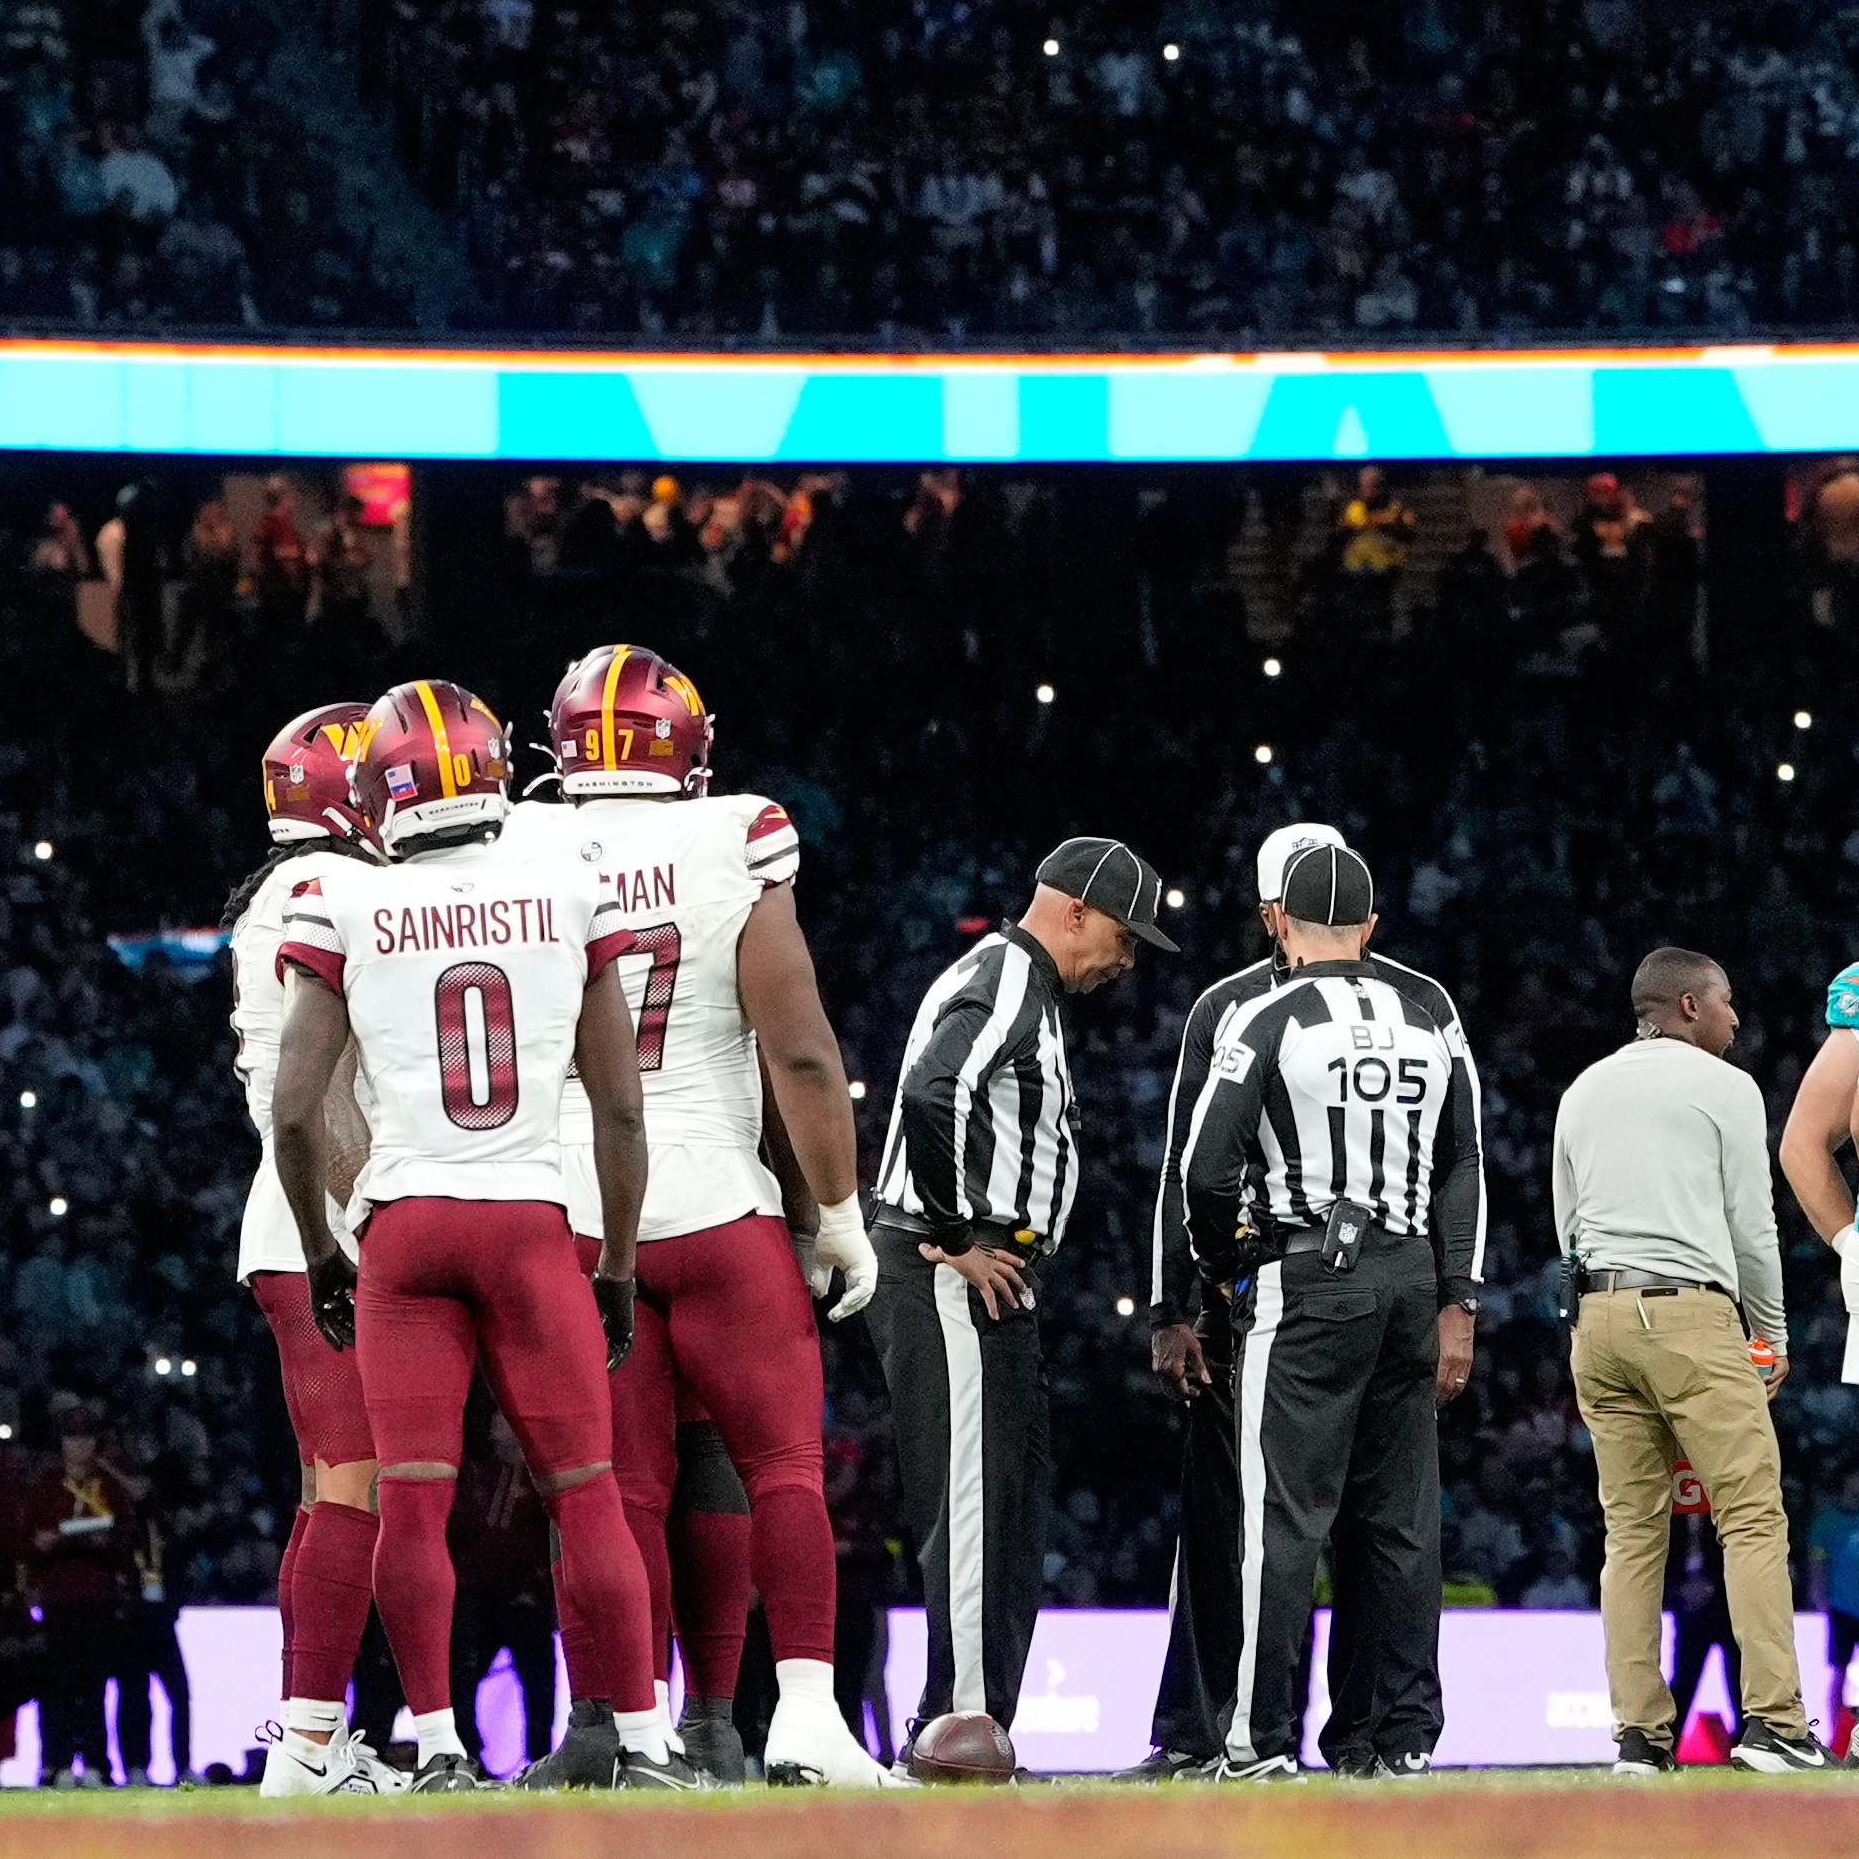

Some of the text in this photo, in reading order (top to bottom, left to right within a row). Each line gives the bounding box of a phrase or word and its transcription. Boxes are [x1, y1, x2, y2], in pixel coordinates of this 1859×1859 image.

[453, 753, 471, 787] 0
[577, 779, 653, 788] WASHINGTON
[373, 898, 560, 954] SAINRISTIL
[434, 960, 520, 1131] 0
[1350, 1025, 1395, 1051] BJ
[1212, 1043, 1246, 1074] 05
[1327, 1056, 1429, 1105] 105
[1672, 1470, 1702, 1505] G
